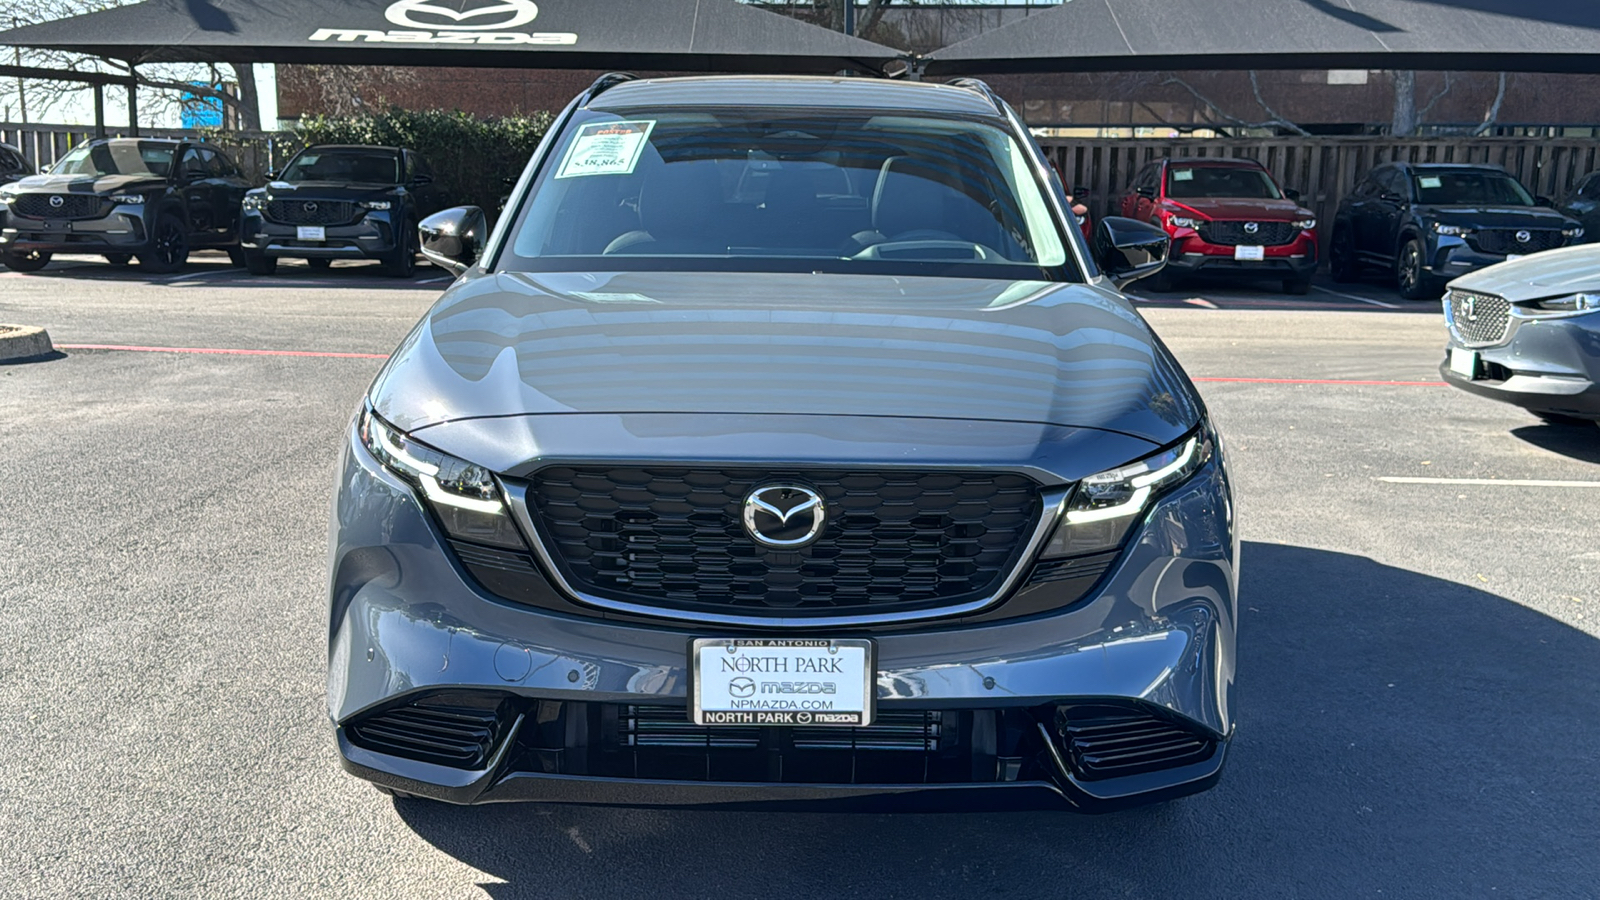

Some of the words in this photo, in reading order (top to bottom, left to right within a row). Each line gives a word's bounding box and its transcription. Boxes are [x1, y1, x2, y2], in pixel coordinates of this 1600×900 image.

[308, 28, 578, 45] mazda
[720, 656, 788, 674] NORTH
[795, 657, 844, 673] PARK
[760, 681, 837, 694] mazda
[730, 699, 834, 710] NPMAZDA.COM
[705, 712, 753, 723] NORTH
[757, 712, 794, 723] PARK
[814, 713, 859, 722] mazda
